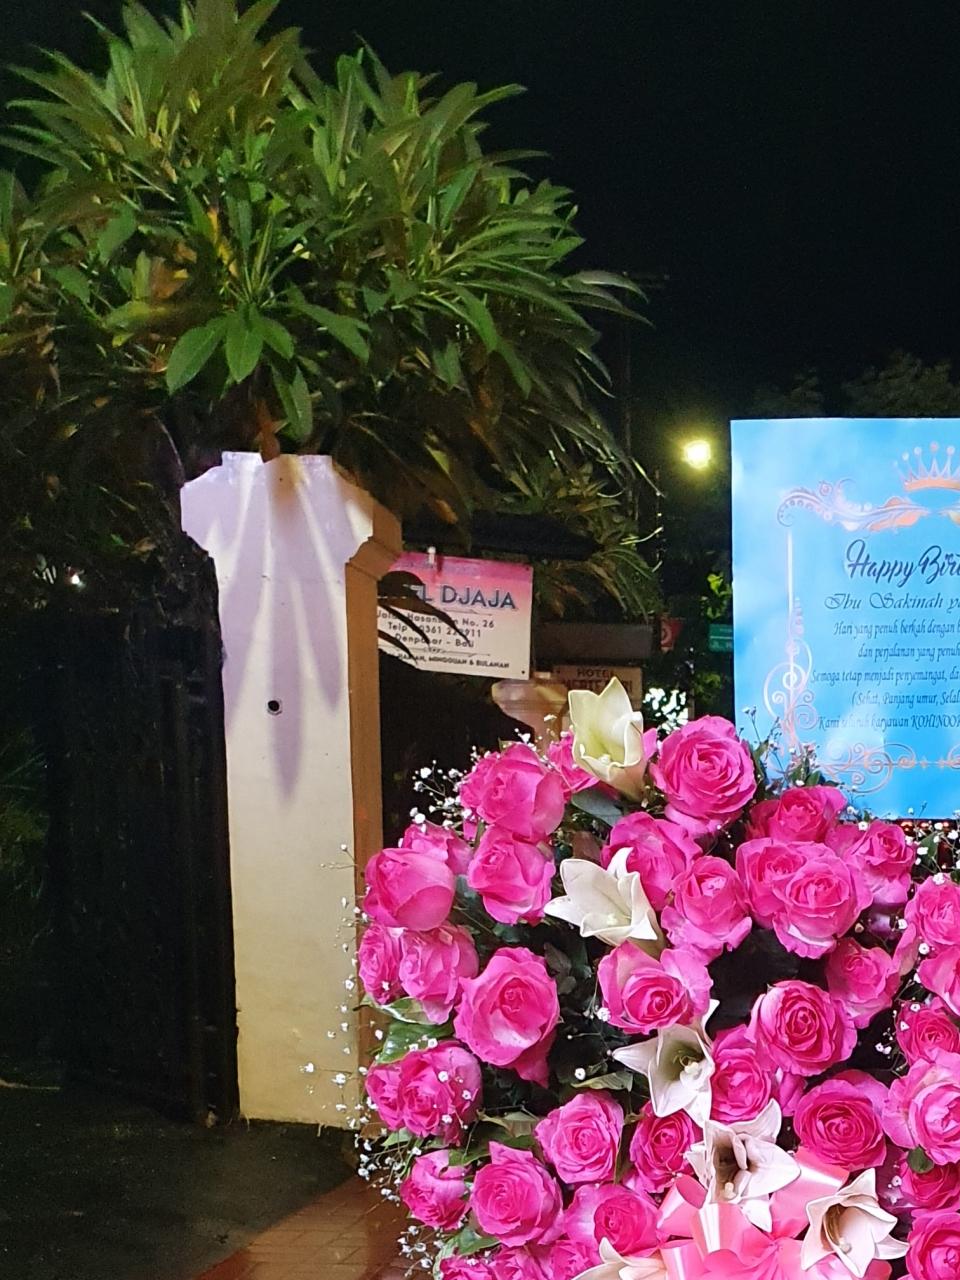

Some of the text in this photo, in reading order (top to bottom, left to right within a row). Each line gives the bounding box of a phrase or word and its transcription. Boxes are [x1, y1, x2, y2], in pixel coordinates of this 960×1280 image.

[846, 539, 916, 588] Happy
[442, 585, 517, 609] DJAJA
[824, 593, 862, 610] Ibu
[869, 592, 943, 609] Sakinah
[388, 621, 408, 633] Telp
[462, 618, 480, 627] No.
[483, 619, 495, 628] 26
[833, 621, 853, 635] Hari
[853, 624, 873, 639] yang
[874, 620, 898, 638] penuh
[900, 619, 925, 637] berkah
[927, 619, 955, 637] dengan
[395, 633, 443, 645] Denpaar
[858, 643, 873, 657] dan
[874, 643, 916, 662] perjalanan
[917, 647, 935, 661] yang
[937, 642, 960, 662] penuh
[811, 670, 840, 686] Semoga
[842, 670, 863, 686] tetap
[864, 667, 894, 686] menjadi
[882, 692, 914, 709] Panjang
[916, 694, 938, 706] umur,
